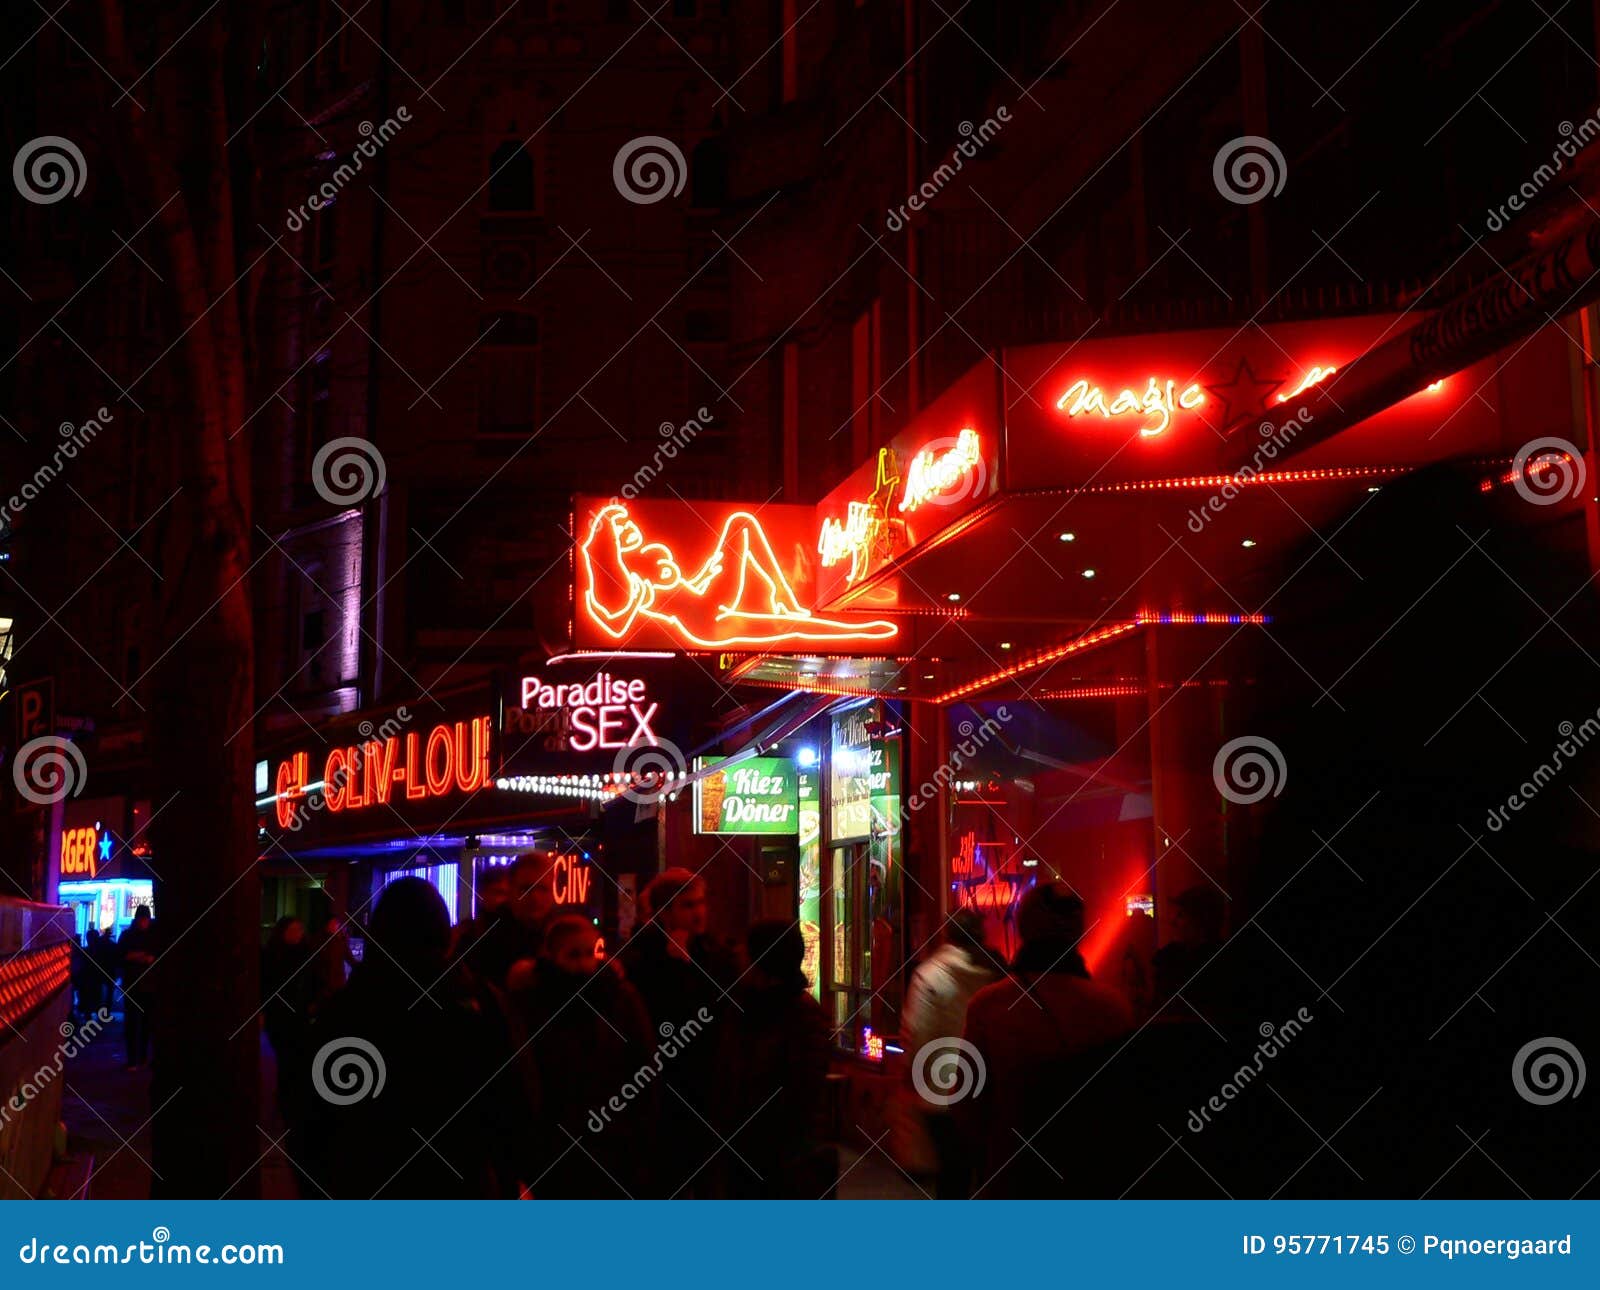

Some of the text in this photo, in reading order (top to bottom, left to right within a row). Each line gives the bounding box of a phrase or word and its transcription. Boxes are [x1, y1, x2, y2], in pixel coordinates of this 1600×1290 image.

[521, 672, 646, 709] Paradise
[569, 702, 658, 751] SEX
[733, 768, 784, 795] Kiez
[722, 796, 795, 822] Döner
